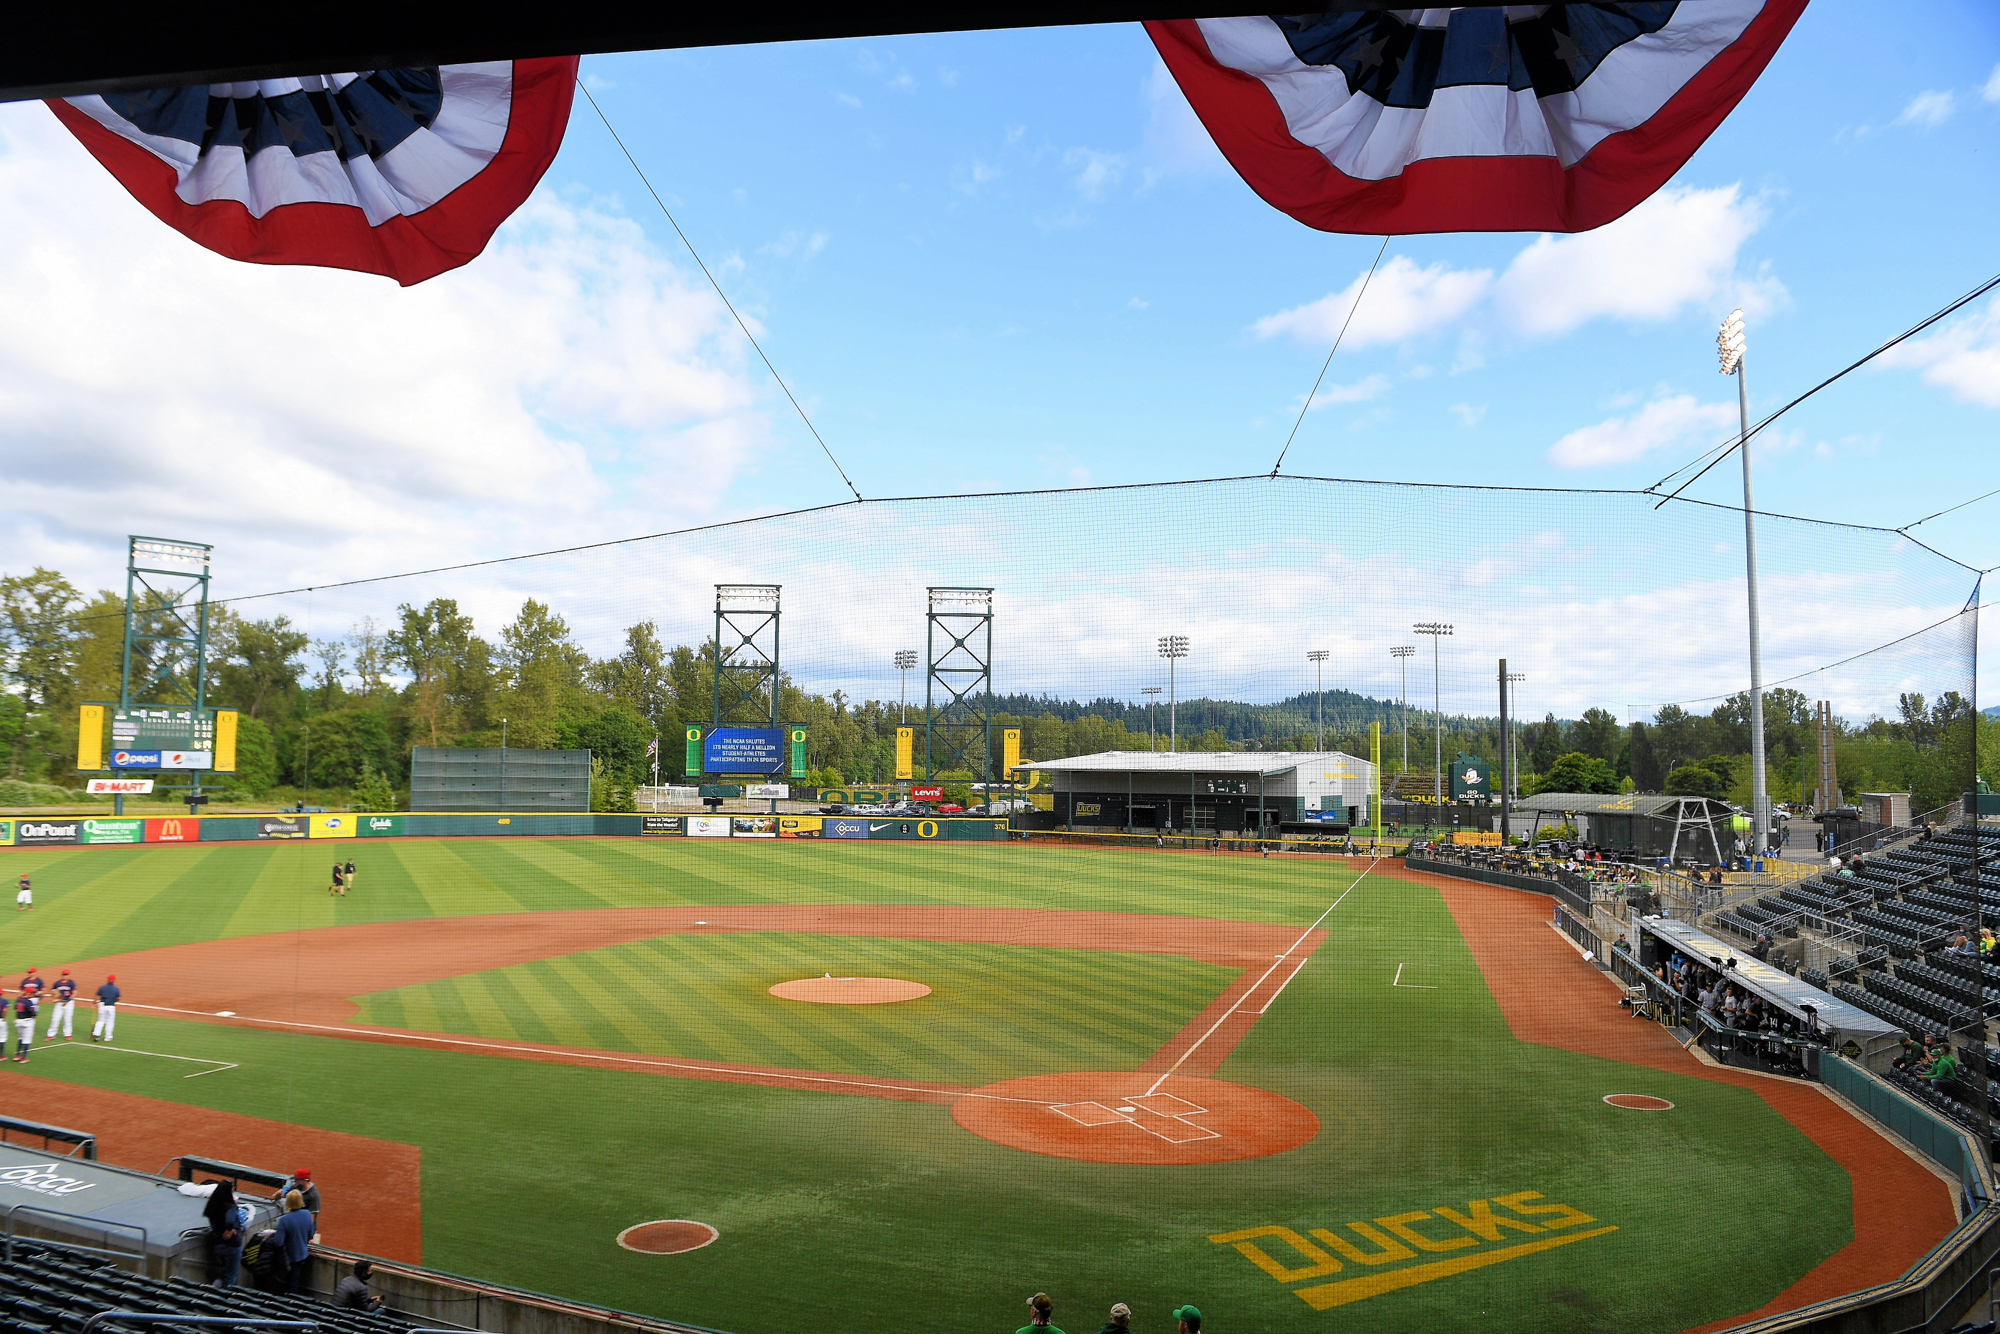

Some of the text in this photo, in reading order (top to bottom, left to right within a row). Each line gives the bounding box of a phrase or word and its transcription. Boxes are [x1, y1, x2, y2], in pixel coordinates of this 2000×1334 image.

[129, 753, 159, 763] pepsi
[94, 782, 146, 792] BI-MART
[20, 823, 77, 837] OnPoint
[83, 820, 138, 835] Quantum
[0, 1169, 97, 1193] OCCU
[1206, 1190, 1598, 1283] DUCKS
